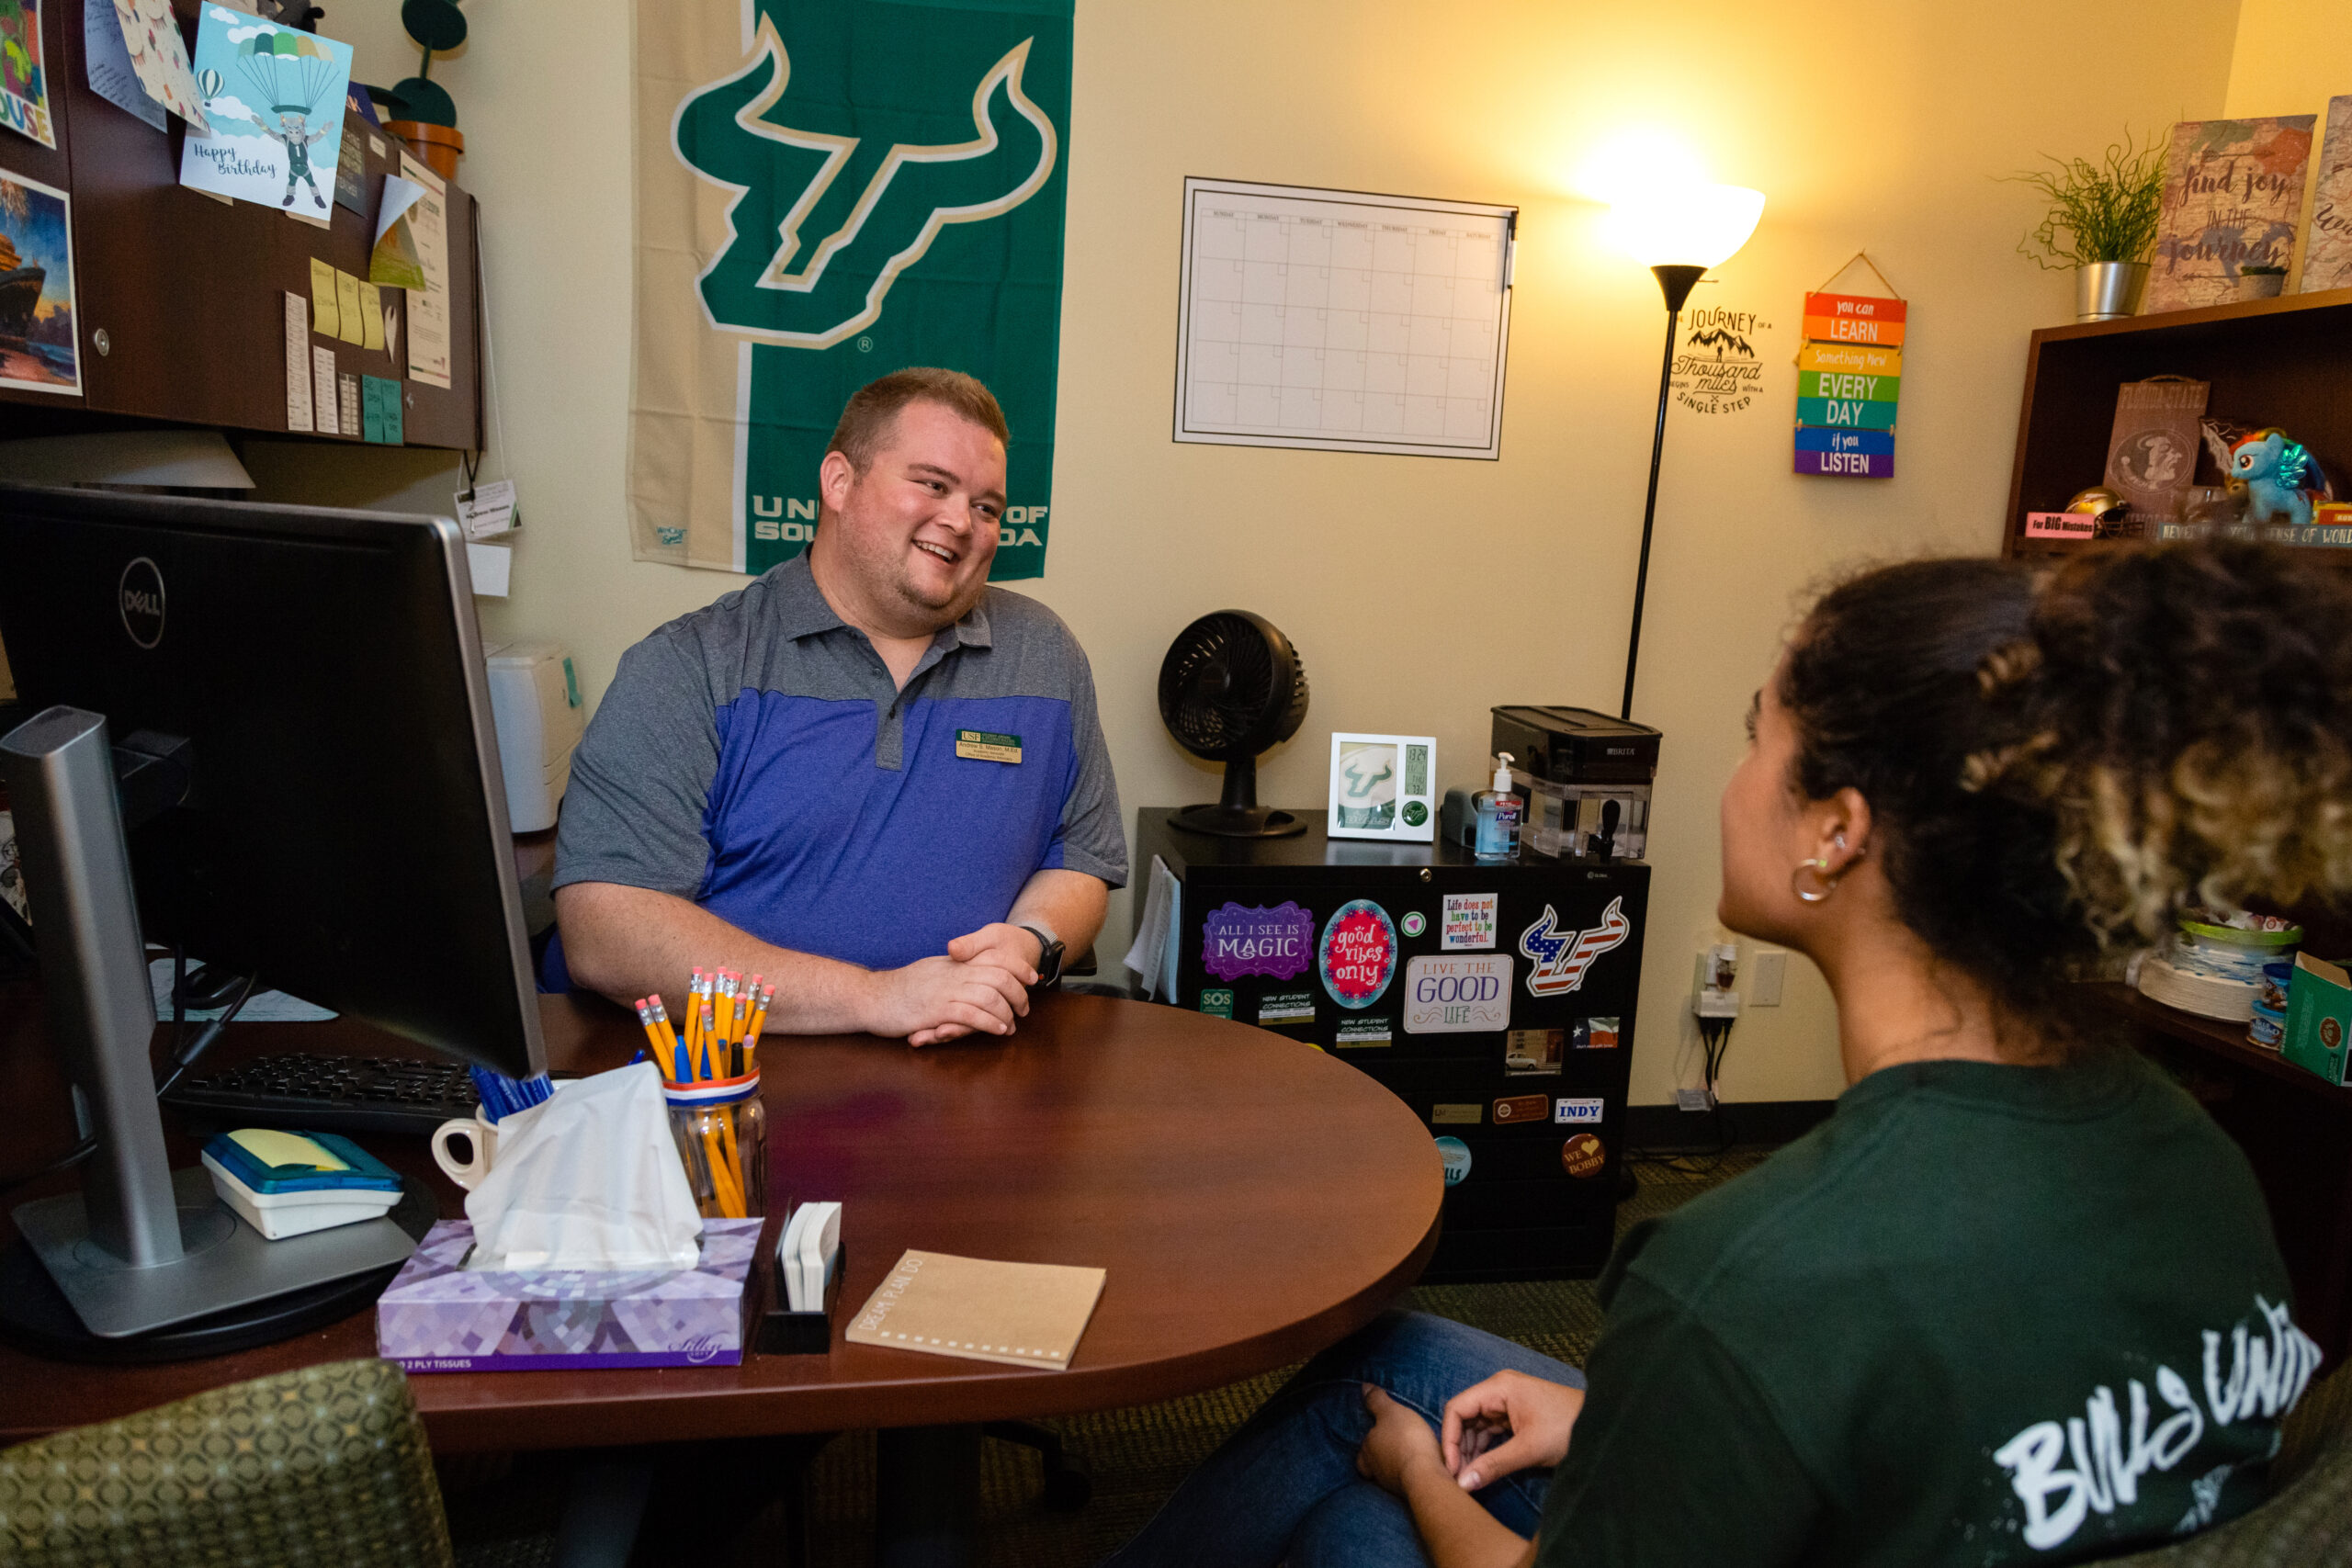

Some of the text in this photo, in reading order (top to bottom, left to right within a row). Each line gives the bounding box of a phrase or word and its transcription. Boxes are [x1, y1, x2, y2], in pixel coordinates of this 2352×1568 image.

[0, 93, 52, 145] OUSE
[194, 143, 235, 162] Happy
[218, 159, 276, 179] Birthday
[2179, 160, 2286, 207] find joy
[2207, 209, 2251, 230] IN THE
[2165, 233, 2286, 276] journey
[1838, 301, 1874, 315] you can
[1688, 306, 1757, 335] JOURNEY
[1830, 320, 1878, 342] LEARN
[1671, 355, 1763, 380] Thousand
[1815, 349, 1864, 370] Something
[1818, 373, 1877, 400] EVERY
[1677, 391, 1751, 413] SINGLE STEP
[1826, 400, 1863, 425] DAY
[1832, 432, 1859, 451] if you
[1821, 452, 1870, 474] LISTEN
[2032, 516, 2093, 532] For BIG Mistakes
[2301, 528, 2316, 543] OF
[125, 590, 160, 615] DELL
[963, 732, 980, 741] USF
[1613, 748, 1635, 756] BRITA
[1447, 898, 1493, 910] Life does not
[1451, 909, 1488, 921] have to be
[1218, 925, 1299, 935] ALL I SEE IS
[1446, 919, 1492, 935] perfect to be
[1335, 924, 1375, 953] good
[1217, 938, 1299, 960] MAGIC
[1345, 944, 1384, 964] vibes
[1336, 965, 1378, 986] only
[1423, 962, 1496, 975] LIVE THE
[1204, 992, 1231, 1006] SOS
[1417, 976, 1498, 1003] GOOD
[1262, 1001, 1311, 1010] CONNECTIONS
[1443, 1006, 1470, 1024] LIFE
[1559, 1106, 1600, 1117] INDY
[1565, 1150, 1582, 1162] WE
[1569, 1155, 1604, 1175] BOBBY
[668, 1334, 723, 1355] Silky
[407, 1360, 413, 1369] 2
[415, 1360, 432, 1369] PLY
[434, 1359, 471, 1369] TISSUES
[1993, 1364, 2204, 1551] BULLS
